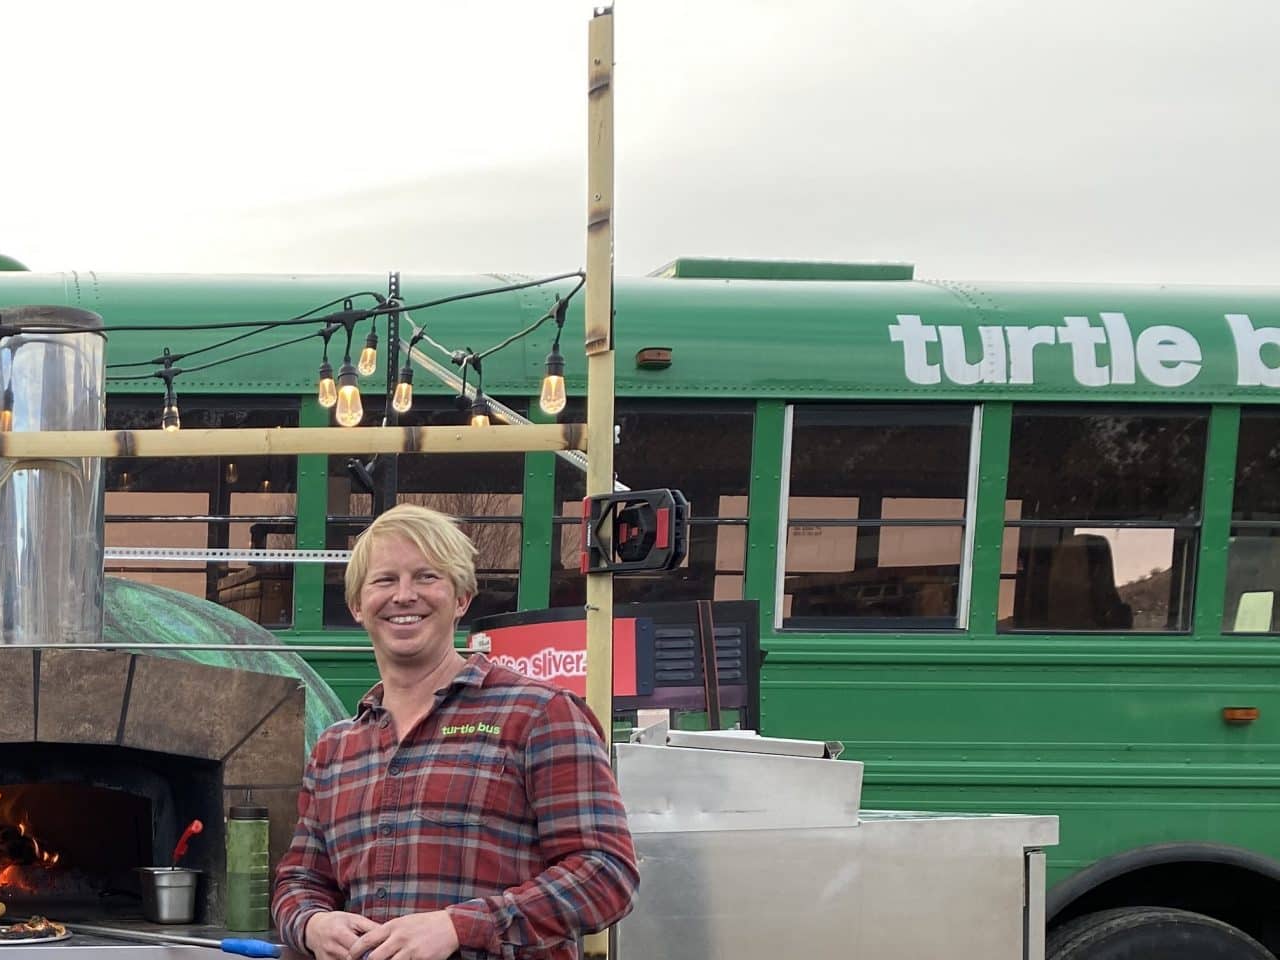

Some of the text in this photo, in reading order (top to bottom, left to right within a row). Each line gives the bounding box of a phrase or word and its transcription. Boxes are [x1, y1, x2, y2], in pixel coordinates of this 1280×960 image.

[888, 313, 1202, 387] turtle
[442, 721, 500, 736] turtle bus
